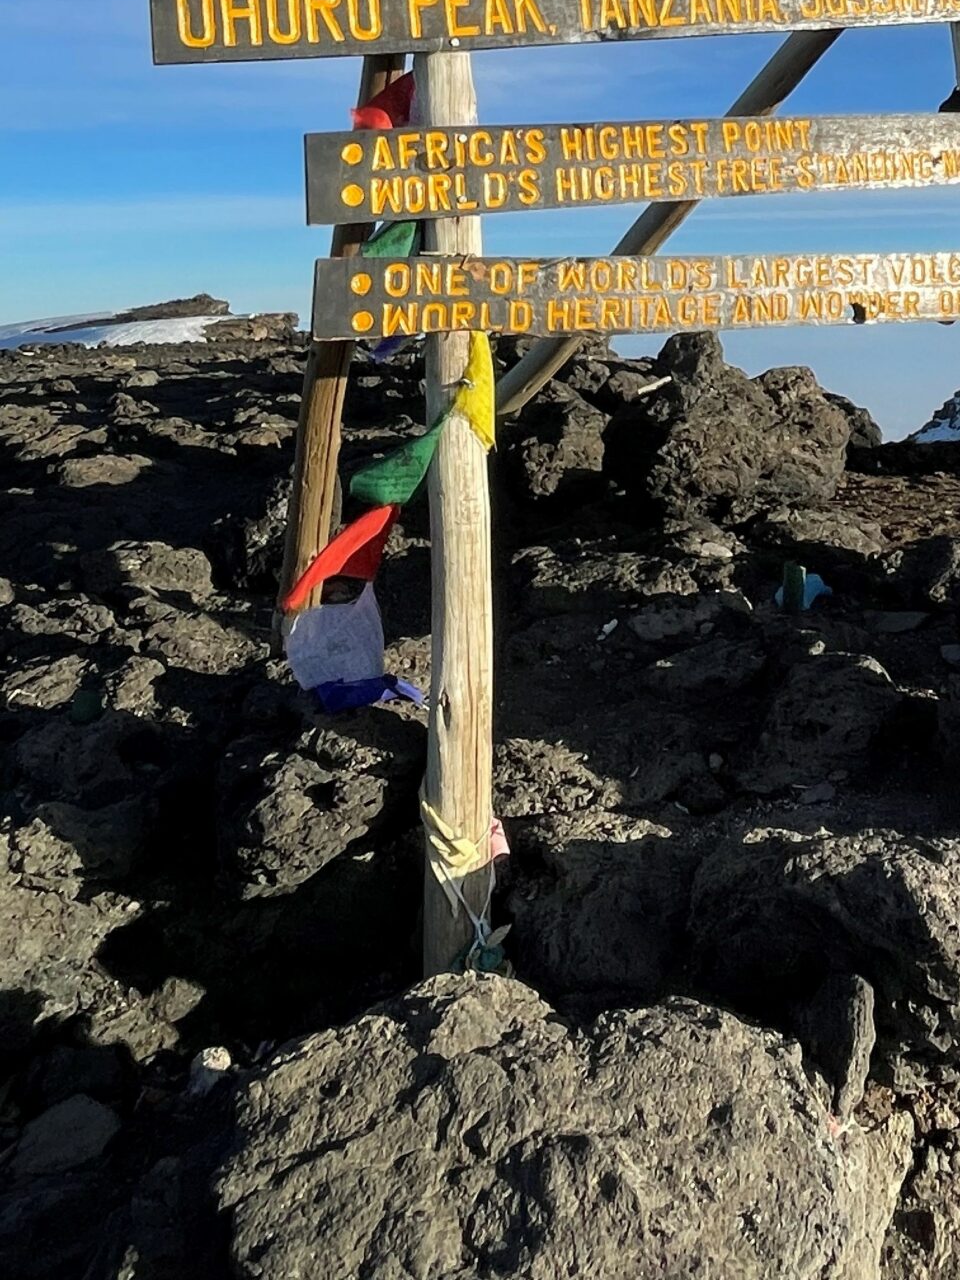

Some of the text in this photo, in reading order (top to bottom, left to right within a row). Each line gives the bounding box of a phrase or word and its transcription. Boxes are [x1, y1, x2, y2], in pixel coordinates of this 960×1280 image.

[372, 119, 812, 170] AFRICA'S HIGHEST POINT
[370, 169, 540, 214] WORLD'S
[556, 160, 705, 202] HIGHEST
[716, 157, 784, 192] FREE
[796, 150, 932, 187] STANDING
[384, 262, 470, 297] ONE
[490, 261, 539, 295] OF
[727, 257, 873, 289] LARGEST
[383, 300, 533, 337] WORLD
[547, 294, 722, 330] HERITAGE
[732, 291, 788, 324] AND
